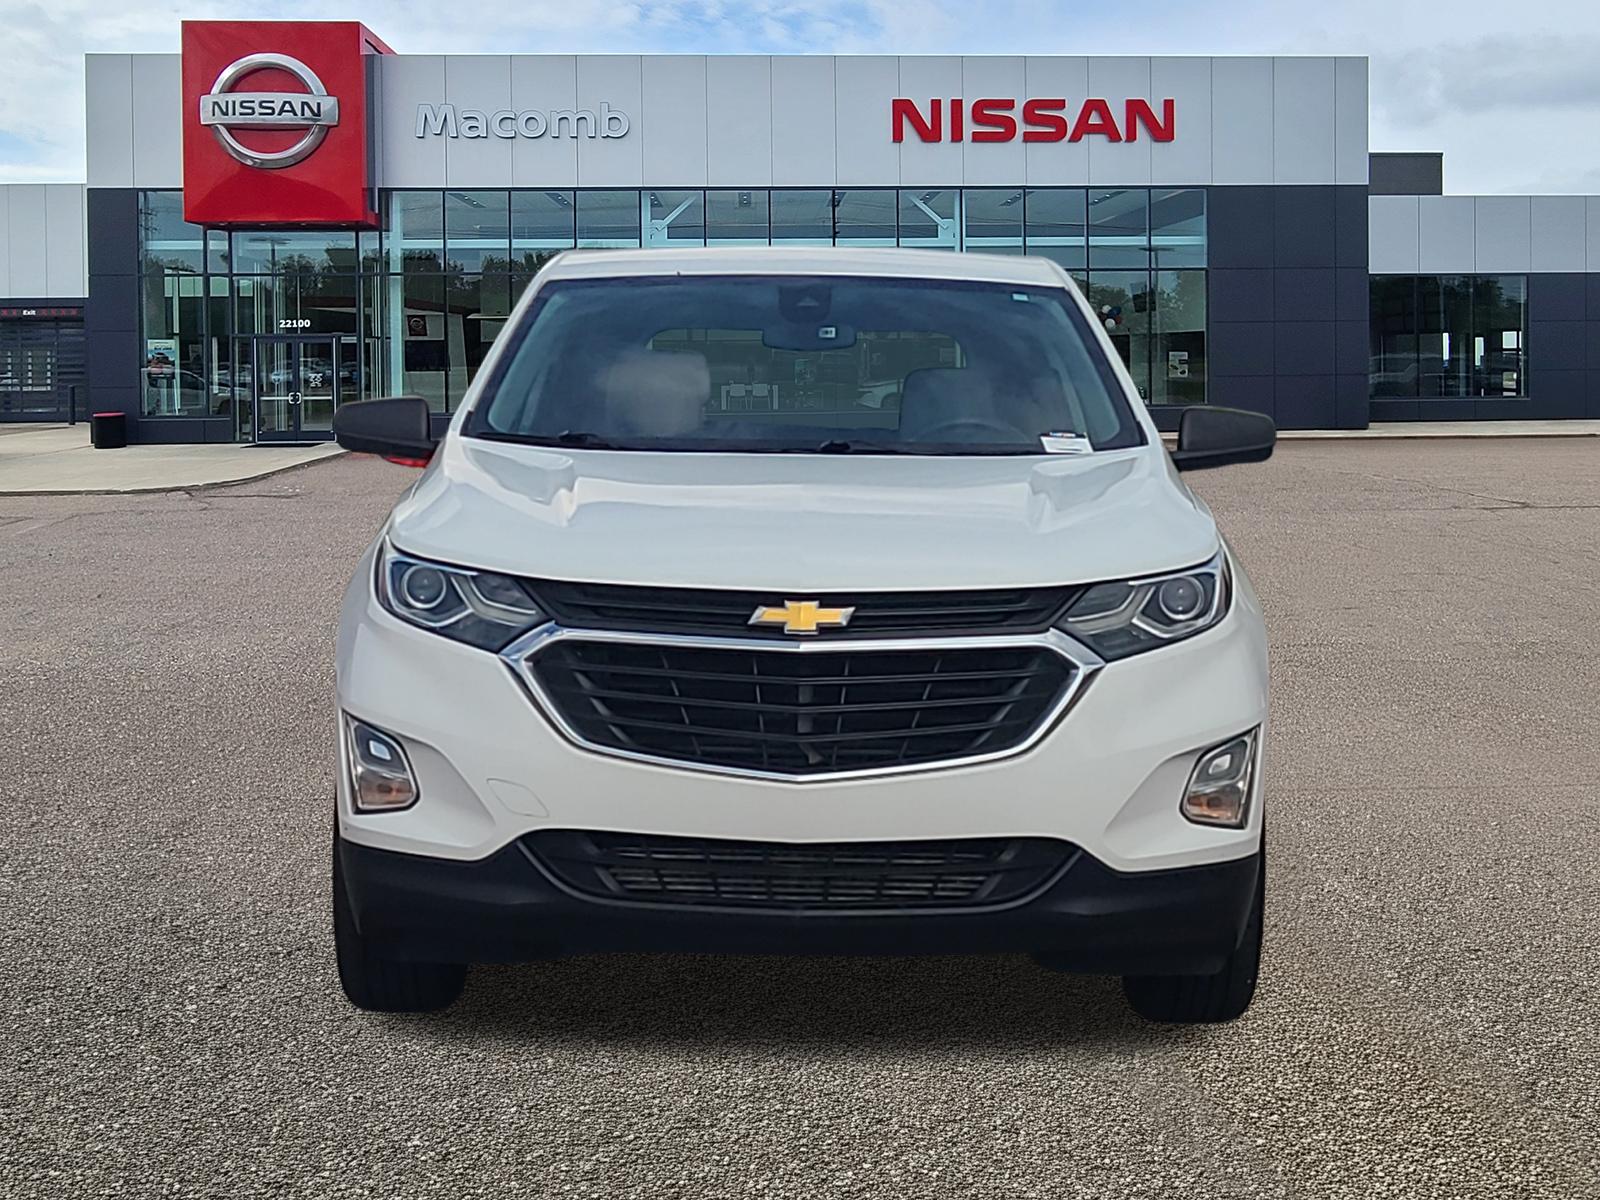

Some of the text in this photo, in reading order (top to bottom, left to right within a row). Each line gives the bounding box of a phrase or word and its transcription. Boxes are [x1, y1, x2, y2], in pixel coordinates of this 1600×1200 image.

[211, 100, 321, 117] NISSAN
[415, 102, 630, 138] Macomb
[892, 98, 1175, 143] NISSAN
[279, 319, 311, 328] 22100
